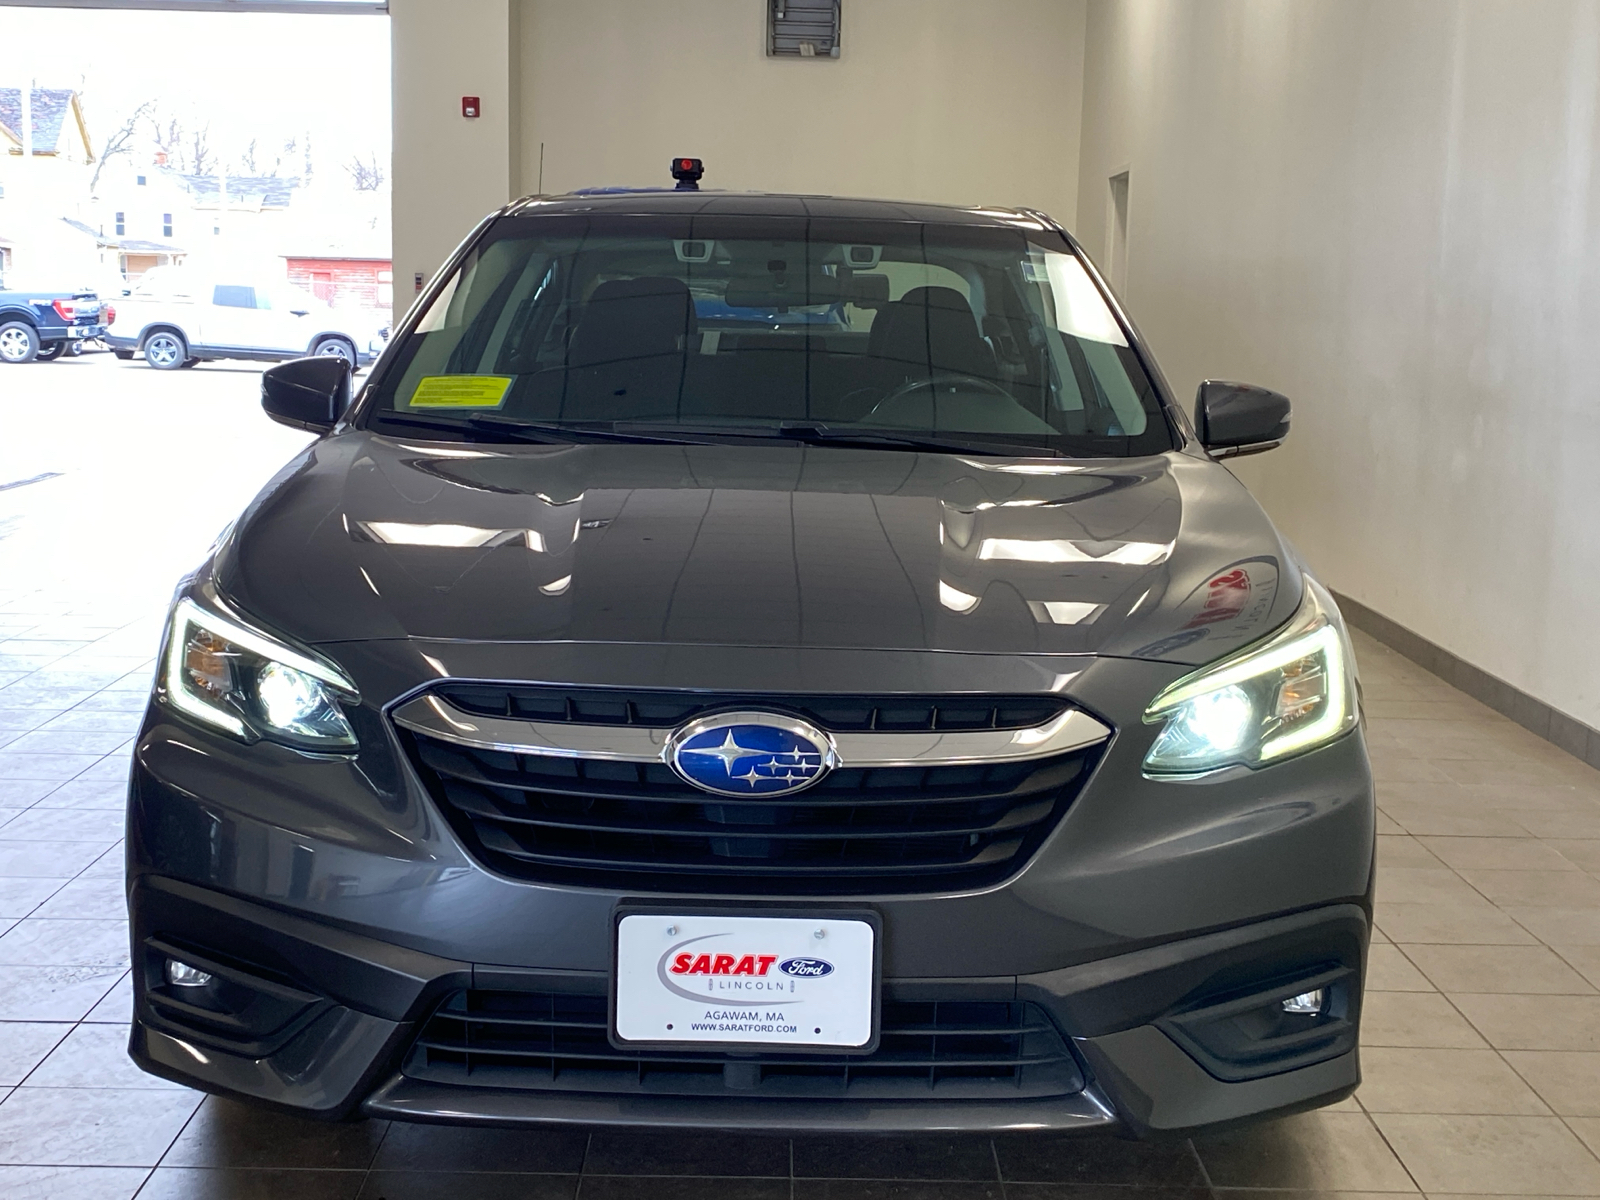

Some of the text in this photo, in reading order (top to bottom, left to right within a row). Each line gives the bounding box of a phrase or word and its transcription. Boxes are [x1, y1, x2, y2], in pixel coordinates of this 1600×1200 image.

[669, 953, 826, 977] SARAT Ford
[719, 981, 784, 991] LINCOLN
[704, 1011, 785, 1022] AGAWAM, MA
[691, 1023, 797, 1033] WWW.SARATFORD.COM
